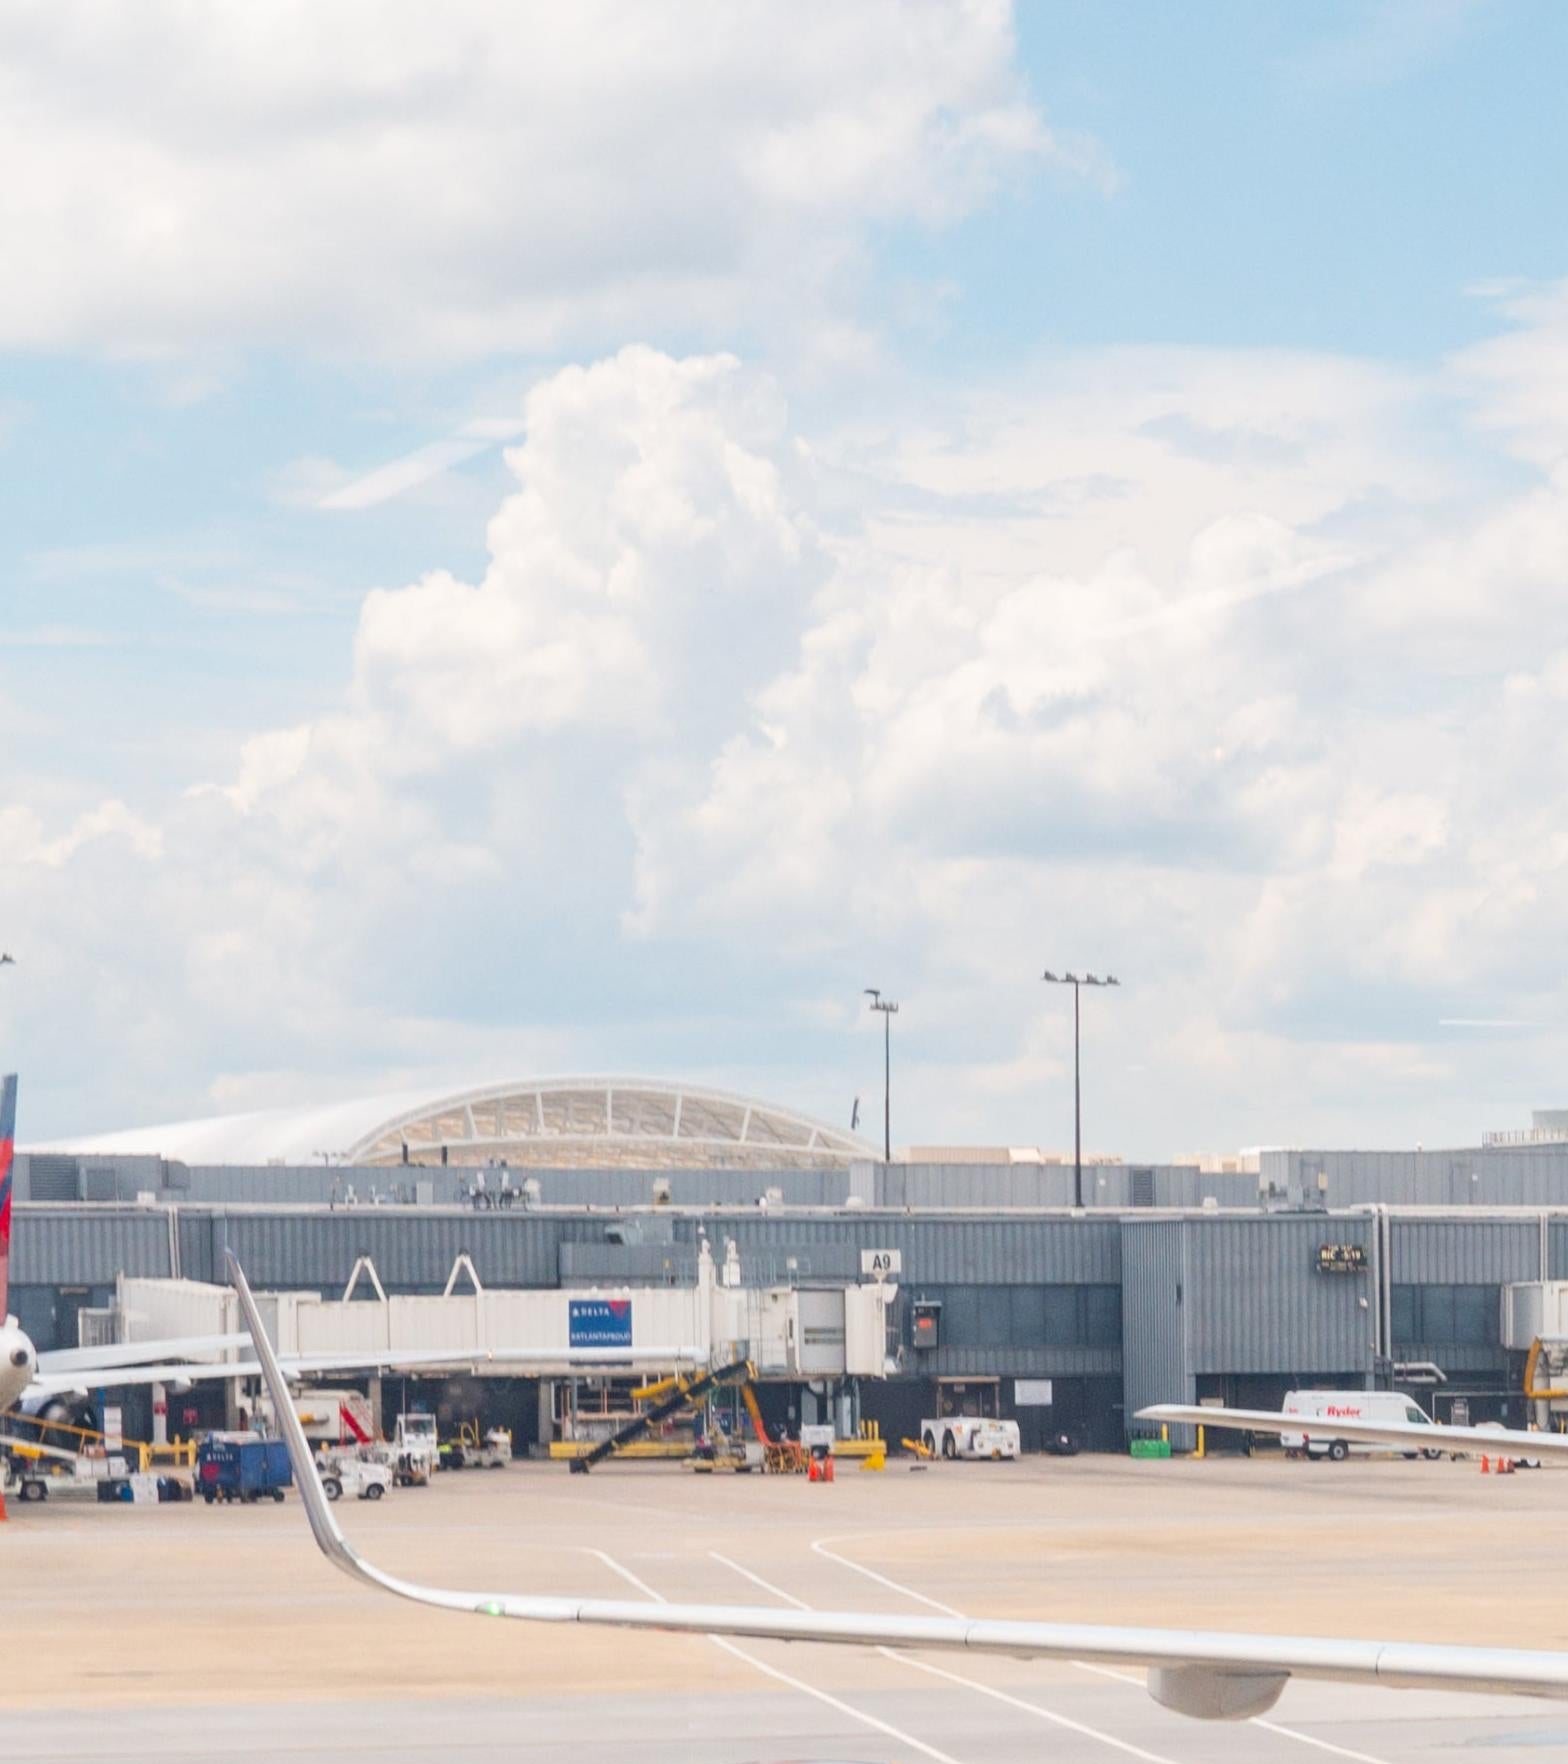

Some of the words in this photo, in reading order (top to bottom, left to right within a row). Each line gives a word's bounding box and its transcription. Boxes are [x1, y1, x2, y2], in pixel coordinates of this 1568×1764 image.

[873, 1254, 890, 1270] A9
[581, 1306, 610, 1316] DELTA
[1327, 1405, 1360, 1417] Ryder
